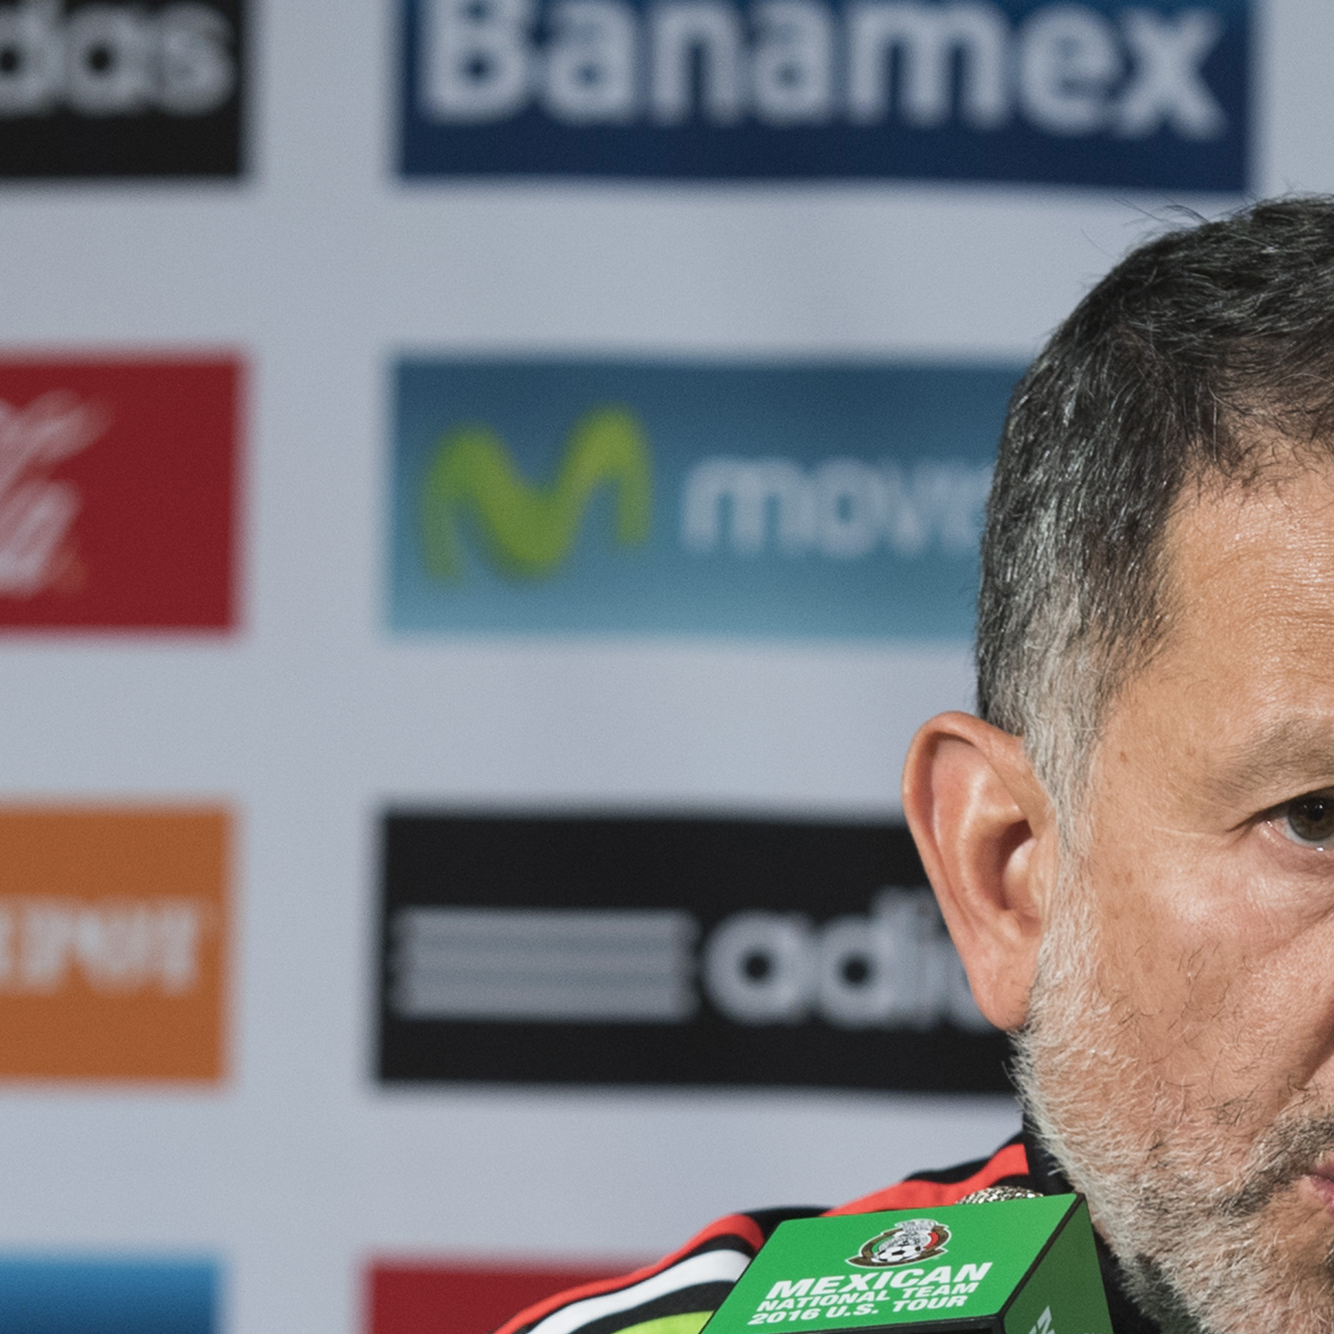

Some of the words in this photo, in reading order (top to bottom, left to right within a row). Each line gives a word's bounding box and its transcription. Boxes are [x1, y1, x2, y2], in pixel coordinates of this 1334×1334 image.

[421, 0, 1227, 139] Banamex
[755, 1289, 891, 1313] NATIONAL
[900, 1281, 980, 1300] TEAM
[765, 1261, 994, 1300] MEXICAN
[746, 1308, 821, 1326] 2016
[824, 1302, 880, 1318] U.S.
[891, 1294, 969, 1313] TOUR
